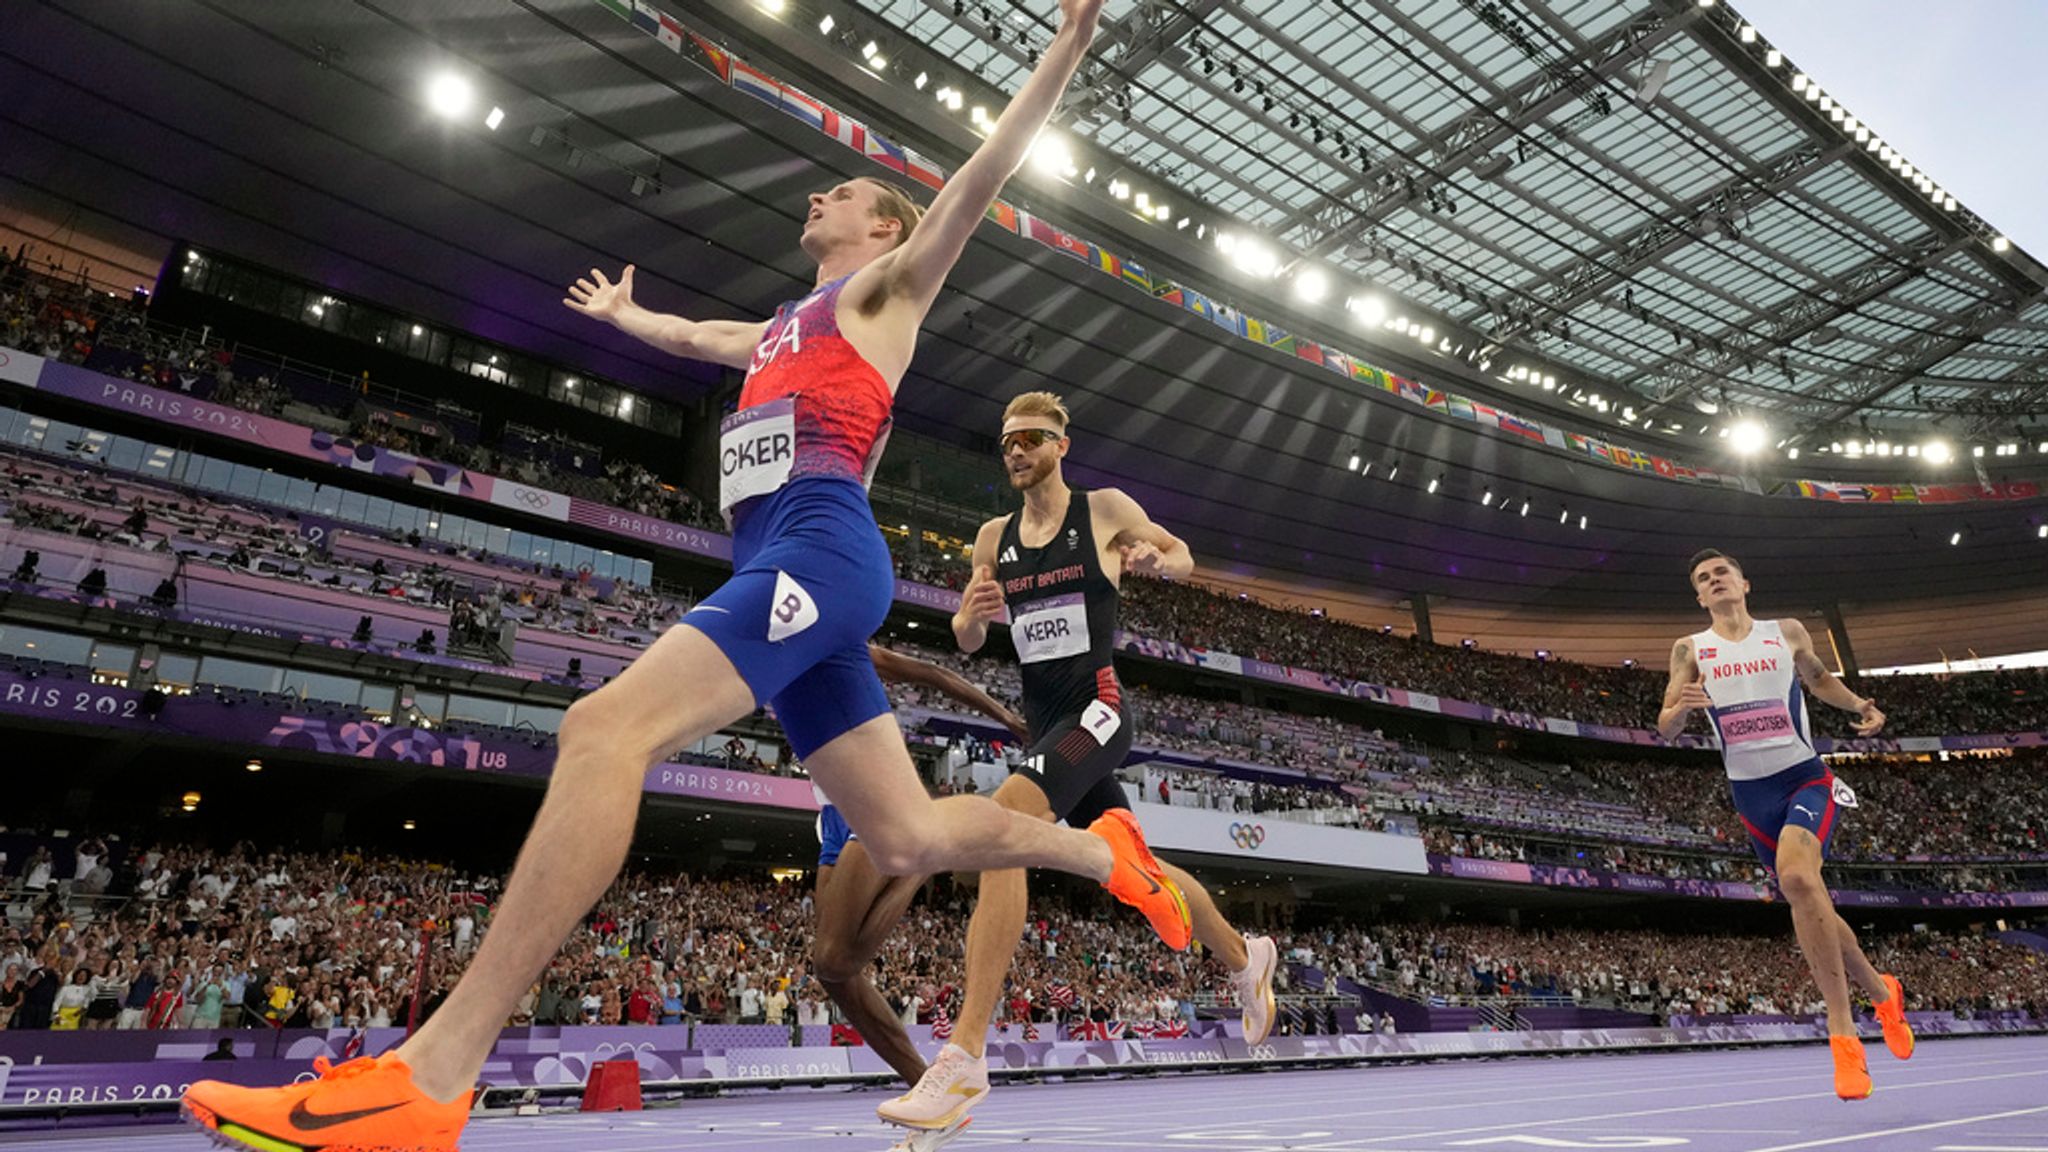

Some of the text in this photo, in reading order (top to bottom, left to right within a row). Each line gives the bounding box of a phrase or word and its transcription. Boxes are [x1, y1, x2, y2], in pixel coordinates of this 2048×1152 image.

[745, 316, 800, 384] SA
[102, 383, 258, 436] PARIS 2024
[608, 513, 710, 549] PARIS 2024
[902, 586, 961, 607] PARIS 20
[1024, 618, 1070, 643] KERR
[1713, 658, 1777, 679] NORWAY
[74, 692, 155, 721] 202
[1094, 710, 1111, 729] 7
[482, 751, 507, 769] U8
[661, 770, 773, 796] PARIS 2024
[738, 1062, 841, 1078] PARIS 2024
[24, 1086, 119, 1105] PARIS
